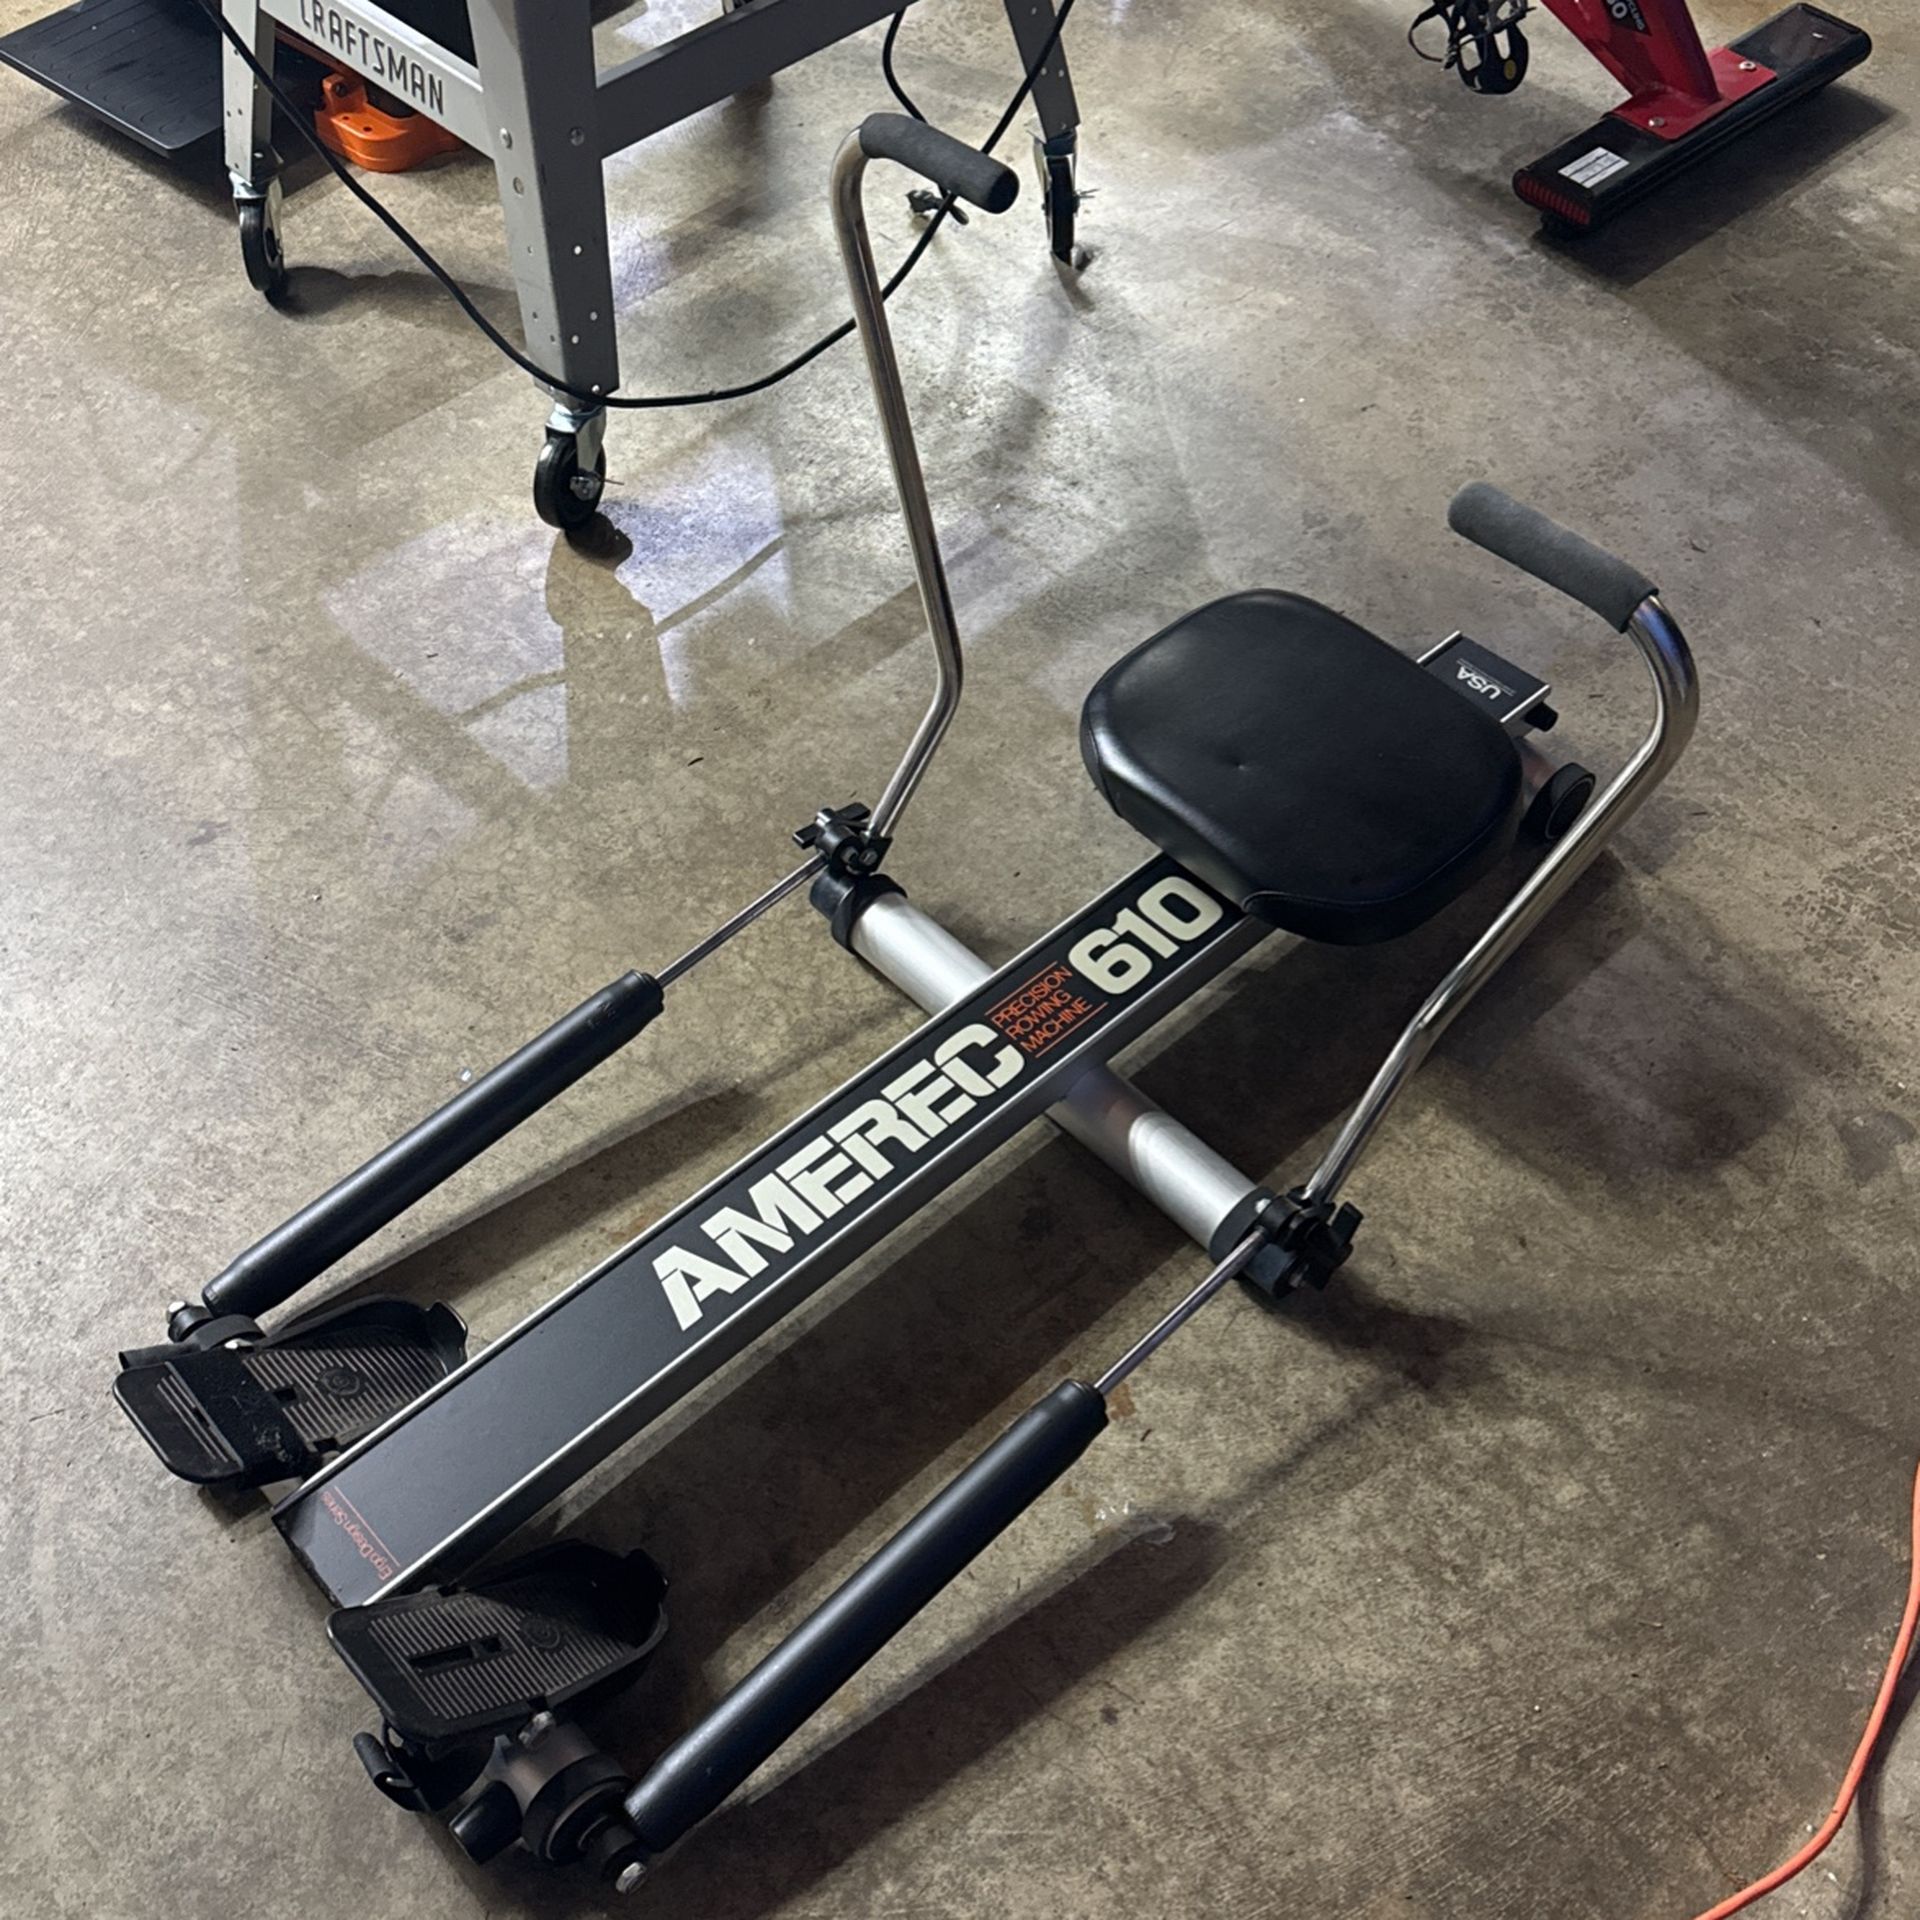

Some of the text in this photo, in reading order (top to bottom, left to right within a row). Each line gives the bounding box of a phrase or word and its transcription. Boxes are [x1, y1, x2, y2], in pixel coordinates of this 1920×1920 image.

[1456, 665, 1502, 700] USA
[1068, 876, 1223, 995] 610
[991, 965, 1073, 1029] PRECISION
[1004, 989, 1073, 1040] ROWING
[1020, 996, 1094, 1052] MACHINE
[651, 1023, 1025, 1332] AMEREC
